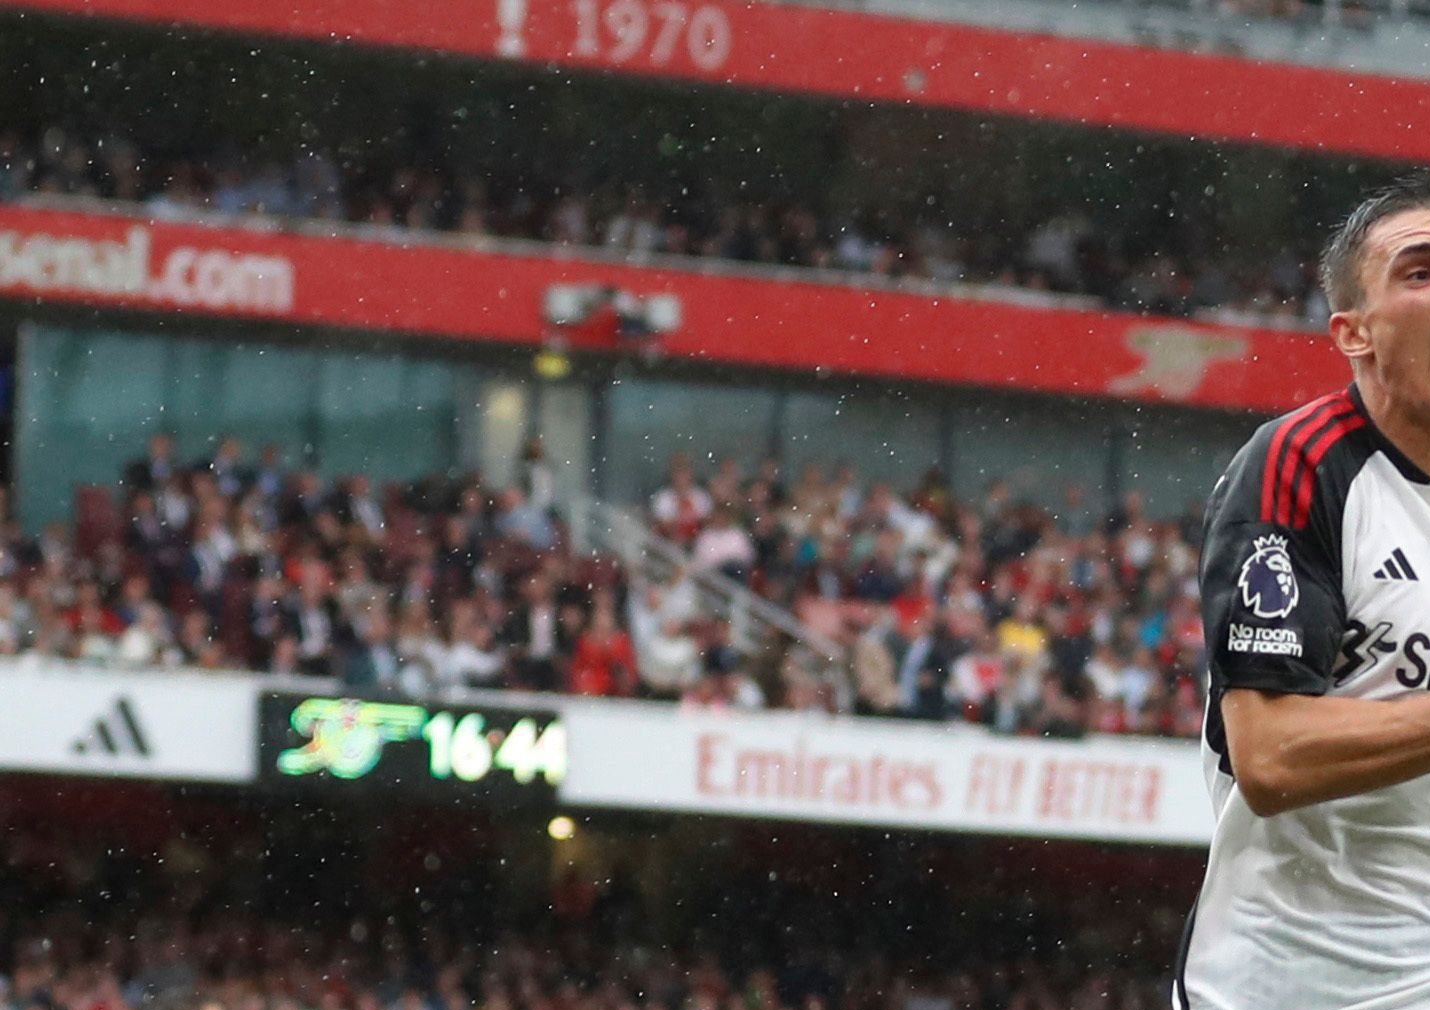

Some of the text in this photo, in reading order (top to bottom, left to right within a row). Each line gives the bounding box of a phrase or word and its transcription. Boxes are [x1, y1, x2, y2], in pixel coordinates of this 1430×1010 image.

[572, 0, 733, 71] 1970
[1229, 623, 1297, 642] No room
[1252, 641, 1303, 658] racism
[694, 731, 942, 810] Emirates
[1037, 757, 1163, 822] BETTER
